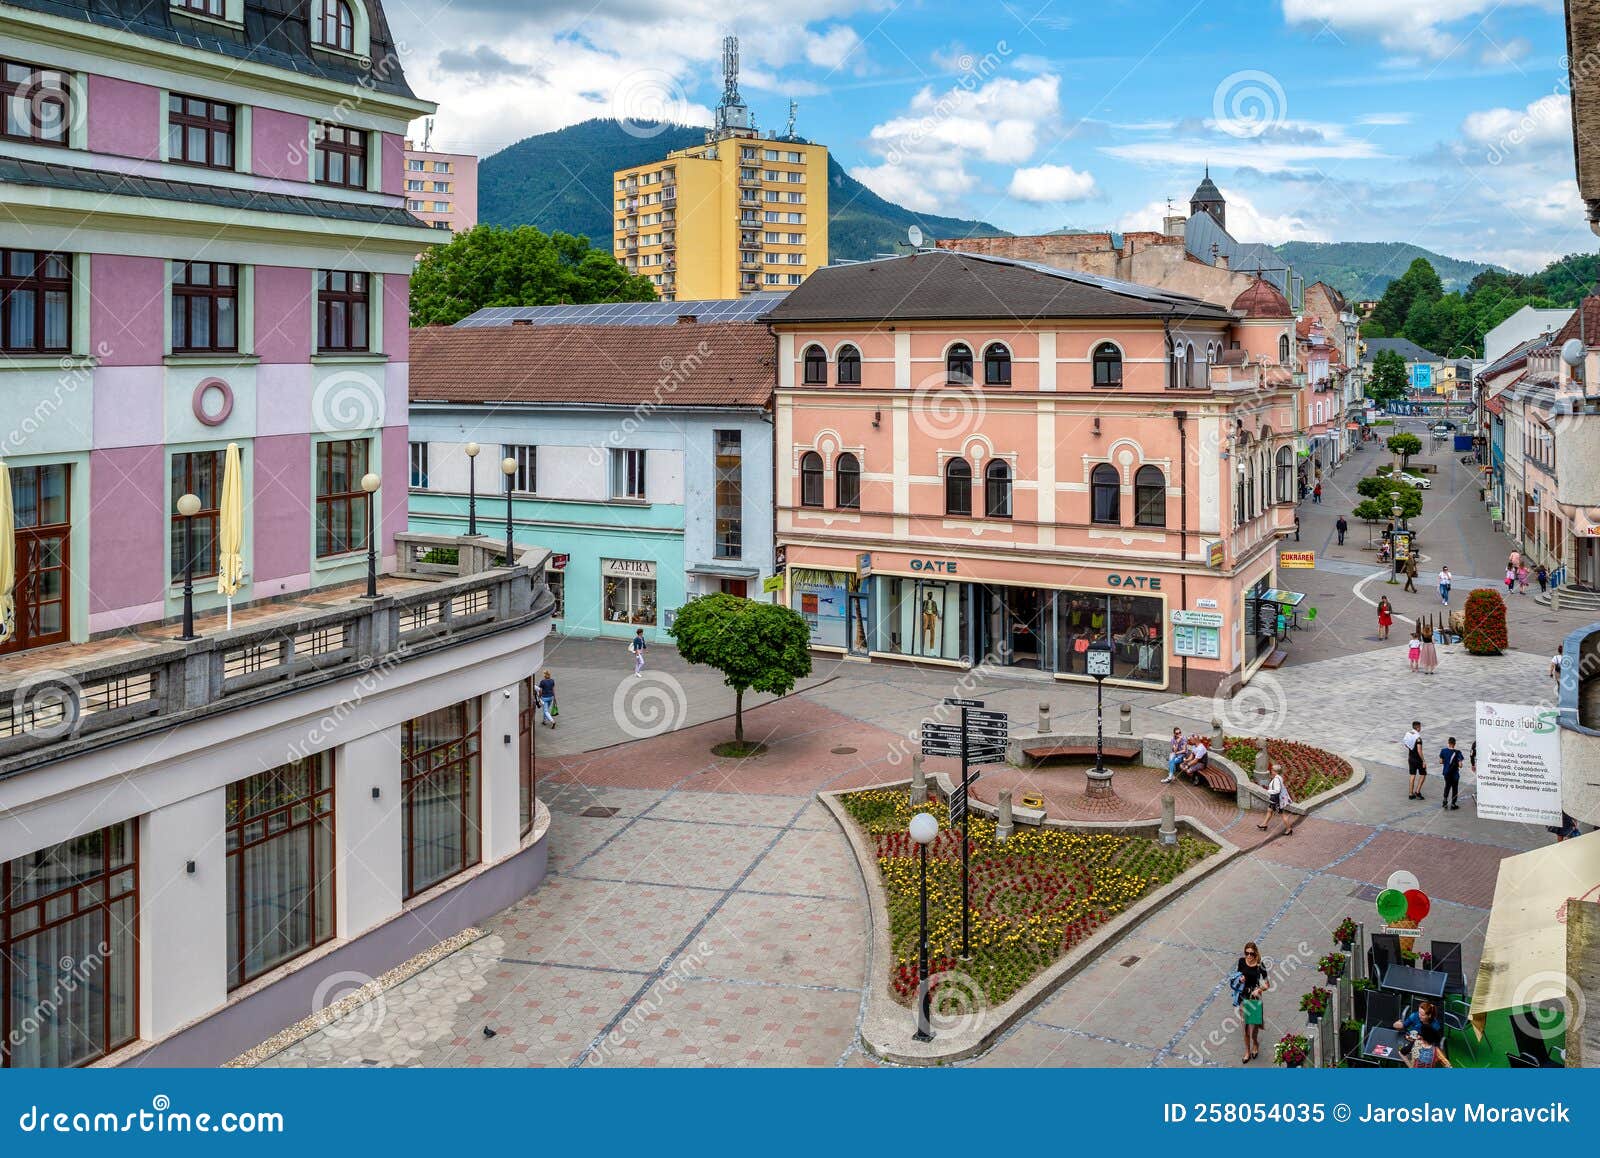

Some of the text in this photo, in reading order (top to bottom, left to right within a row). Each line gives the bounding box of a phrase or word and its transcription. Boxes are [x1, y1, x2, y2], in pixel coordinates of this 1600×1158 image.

[610, 560, 650, 573] ZAFIRA
[910, 558, 957, 574] GATE
[1107, 573, 1162, 590] GATE
